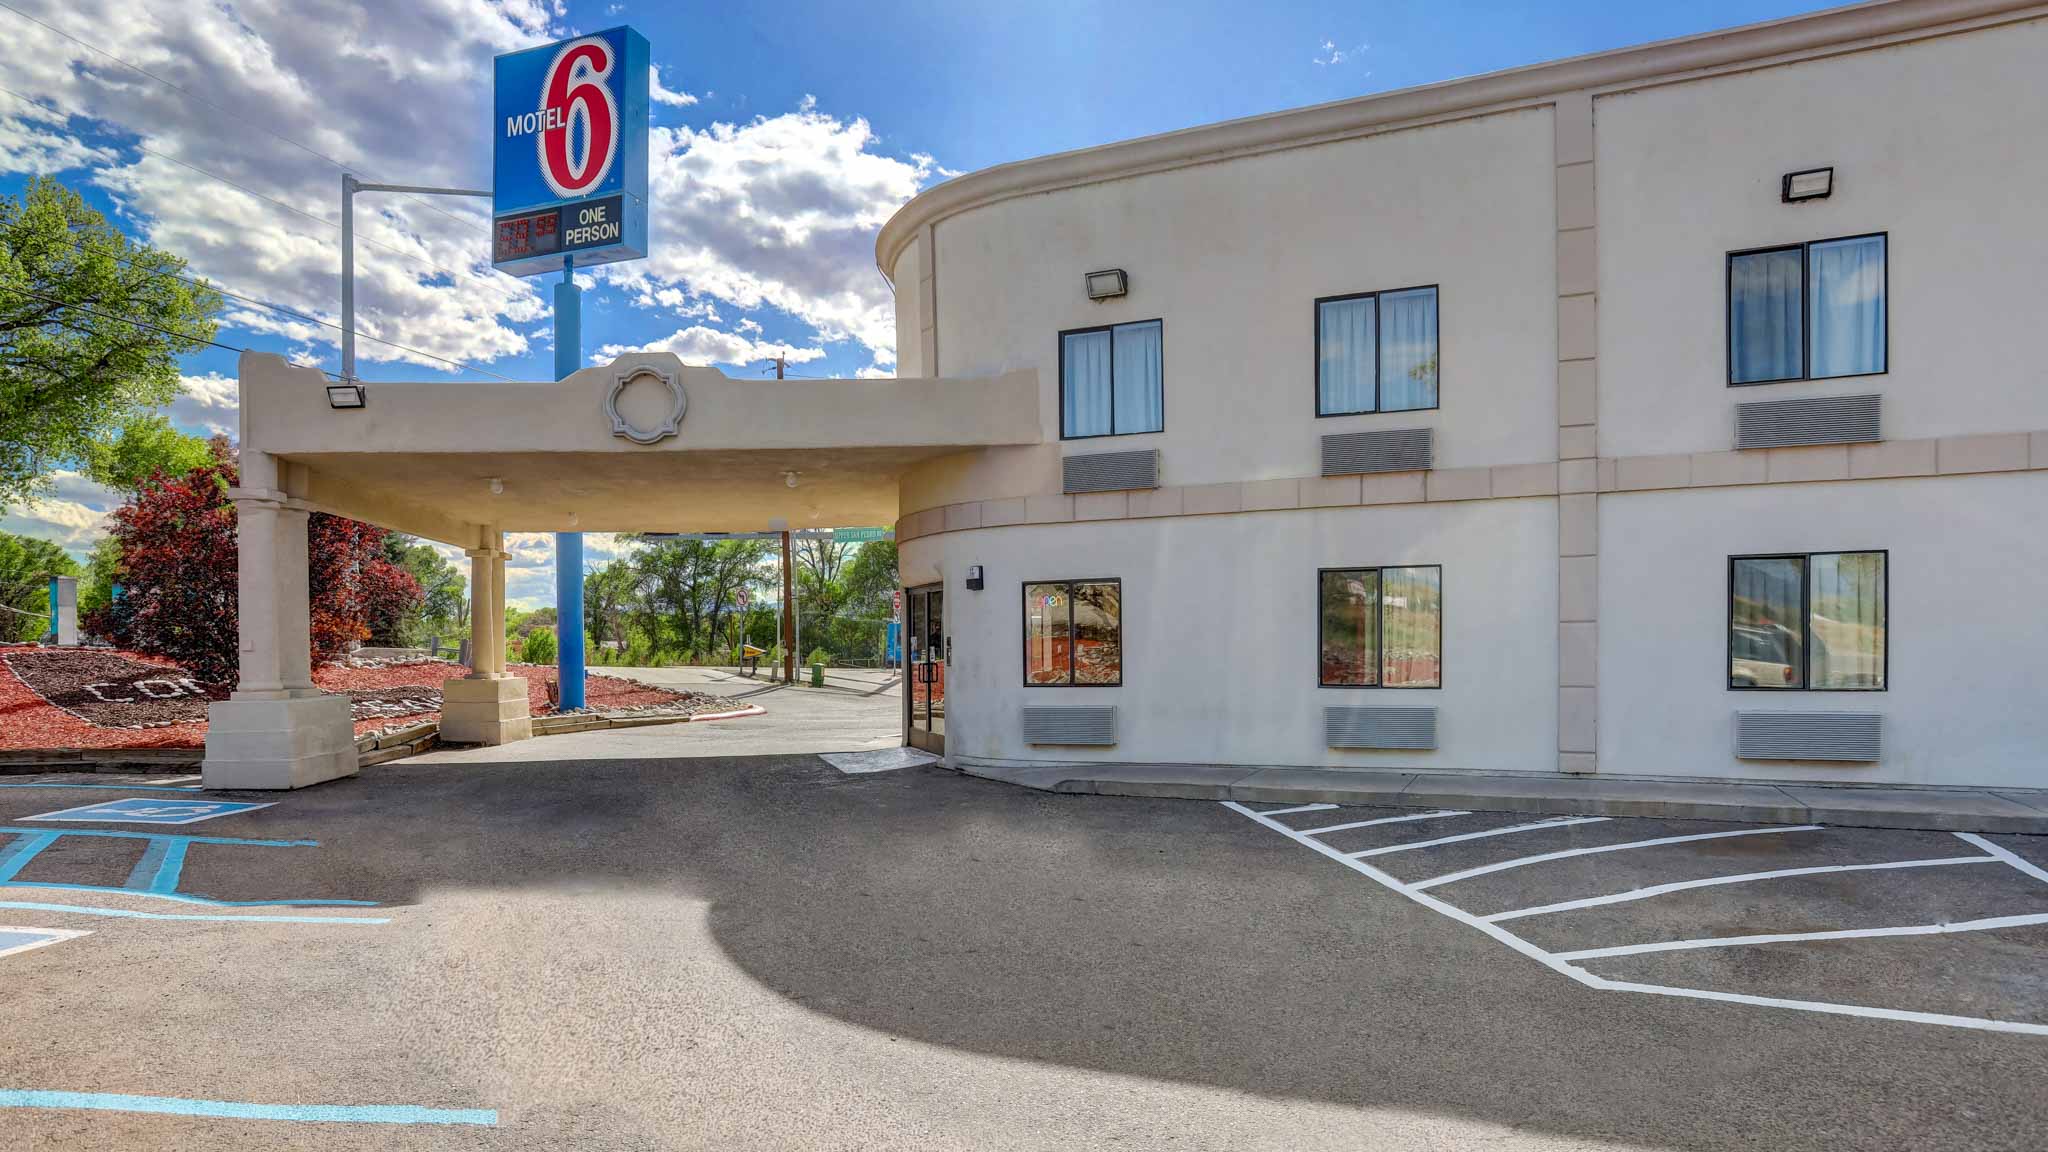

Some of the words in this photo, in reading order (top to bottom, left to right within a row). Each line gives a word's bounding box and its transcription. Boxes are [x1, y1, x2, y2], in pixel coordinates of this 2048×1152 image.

[507, 107, 566, 137] MOTEL
[545, 44, 612, 190] 6
[579, 206, 606, 225] ONE
[565, 222, 619, 245] PERSON
